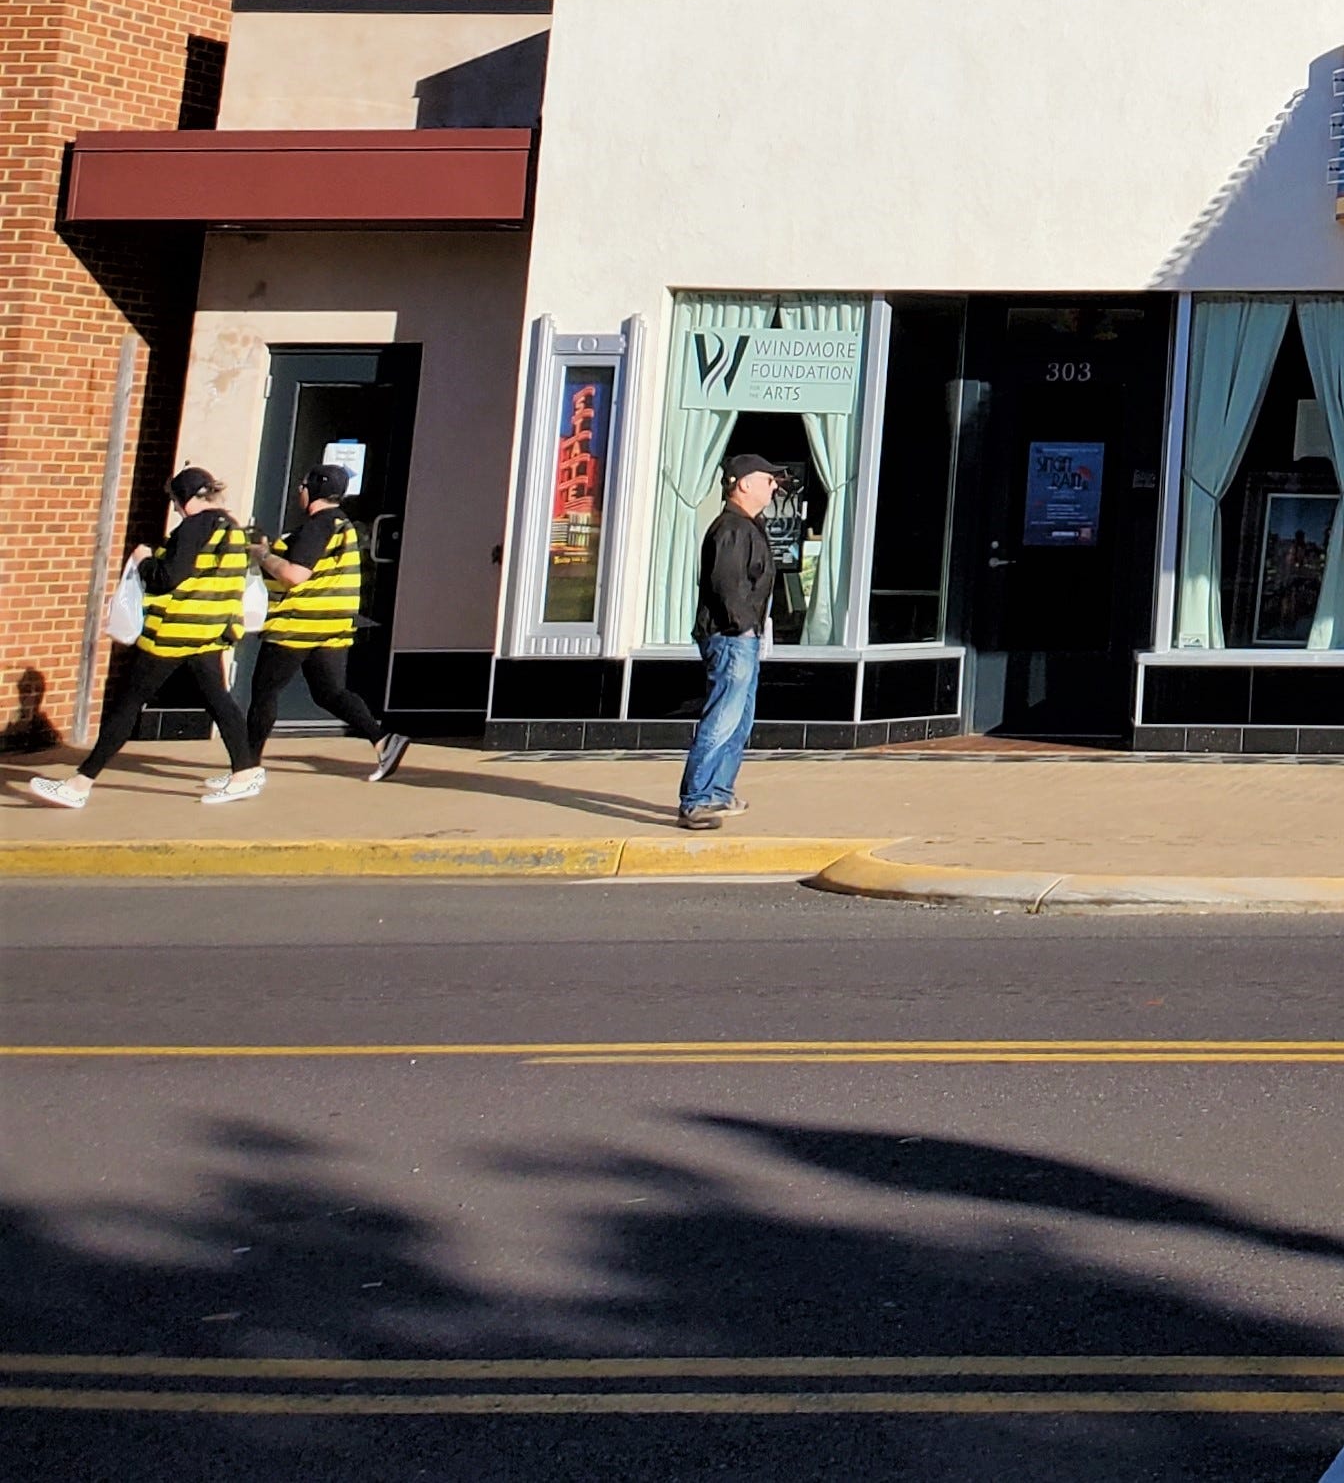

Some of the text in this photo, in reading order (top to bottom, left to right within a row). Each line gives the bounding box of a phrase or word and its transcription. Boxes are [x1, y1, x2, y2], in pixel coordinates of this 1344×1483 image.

[754, 340, 857, 359] WINDMORE
[751, 363, 853, 380] FOUNDATION
[1046, 362, 1091, 382] 303
[762, 386, 801, 401] ARTS
